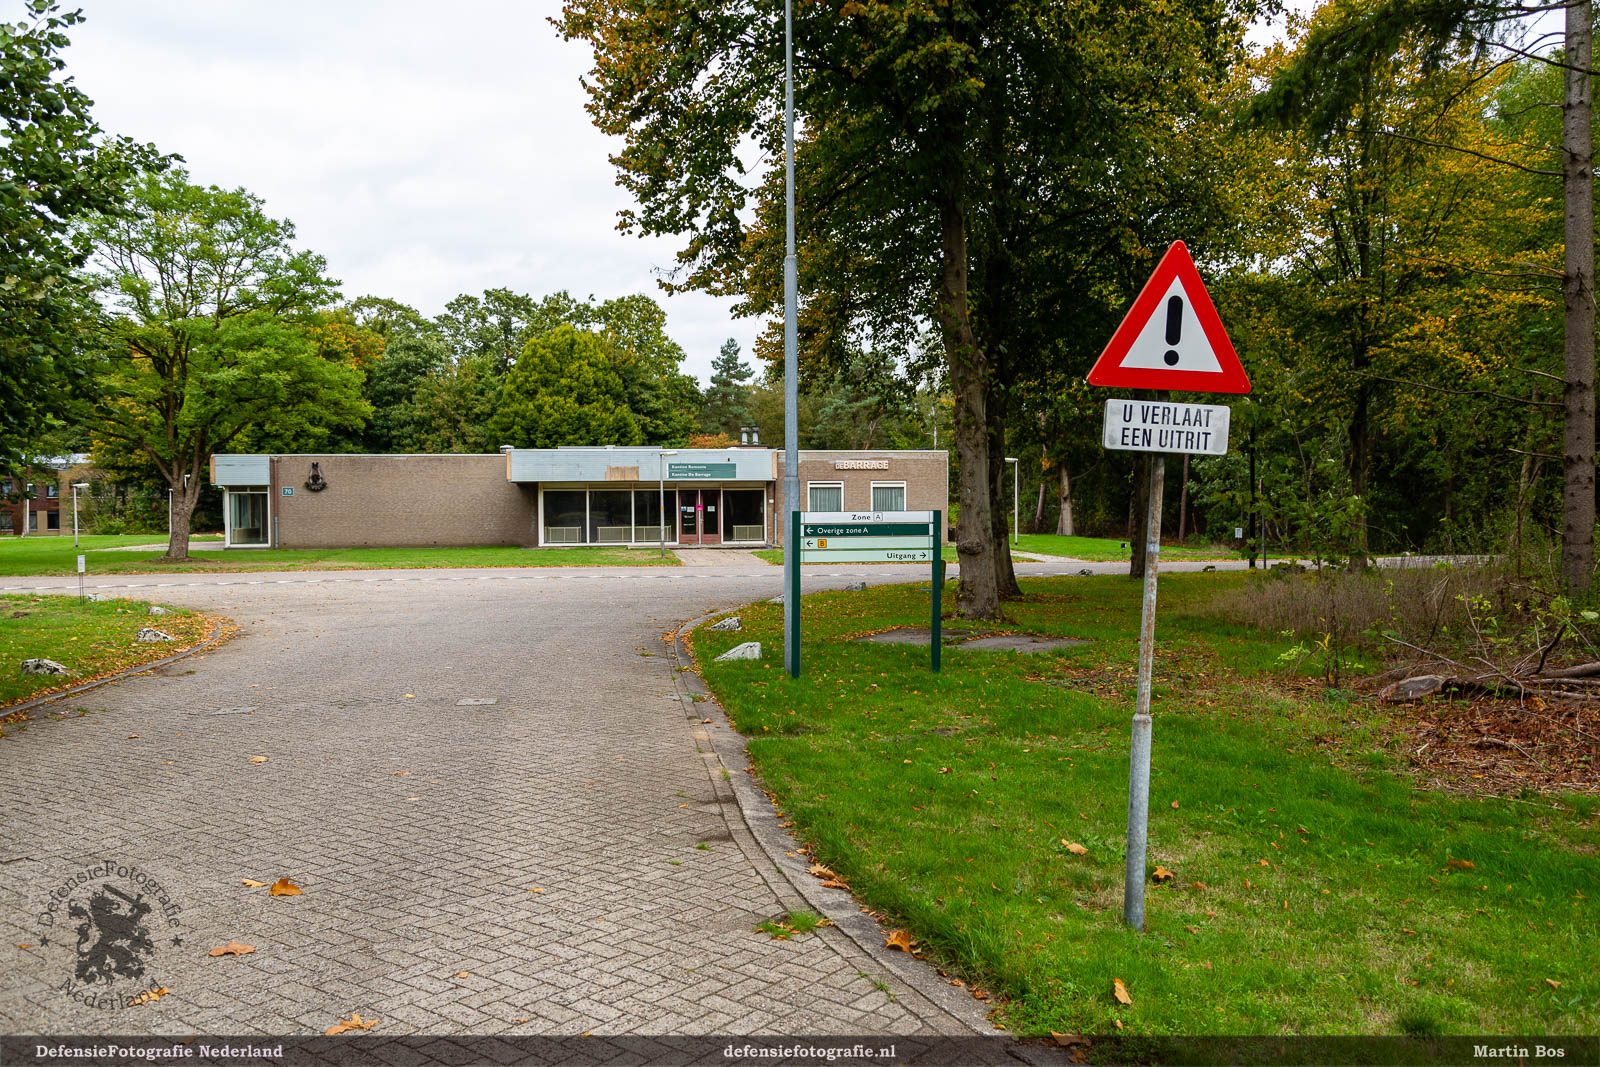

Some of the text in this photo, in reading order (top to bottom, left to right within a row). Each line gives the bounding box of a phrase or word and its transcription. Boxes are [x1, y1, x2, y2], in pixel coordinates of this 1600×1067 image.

[1123, 404, 1213, 428] U VERLAAT
[1121, 427, 1211, 450] EEN UITRIT
[843, 460, 889, 470] BARRAGE
[817, 527, 844, 537] Overige
[886, 552, 916, 560] Uitgang
